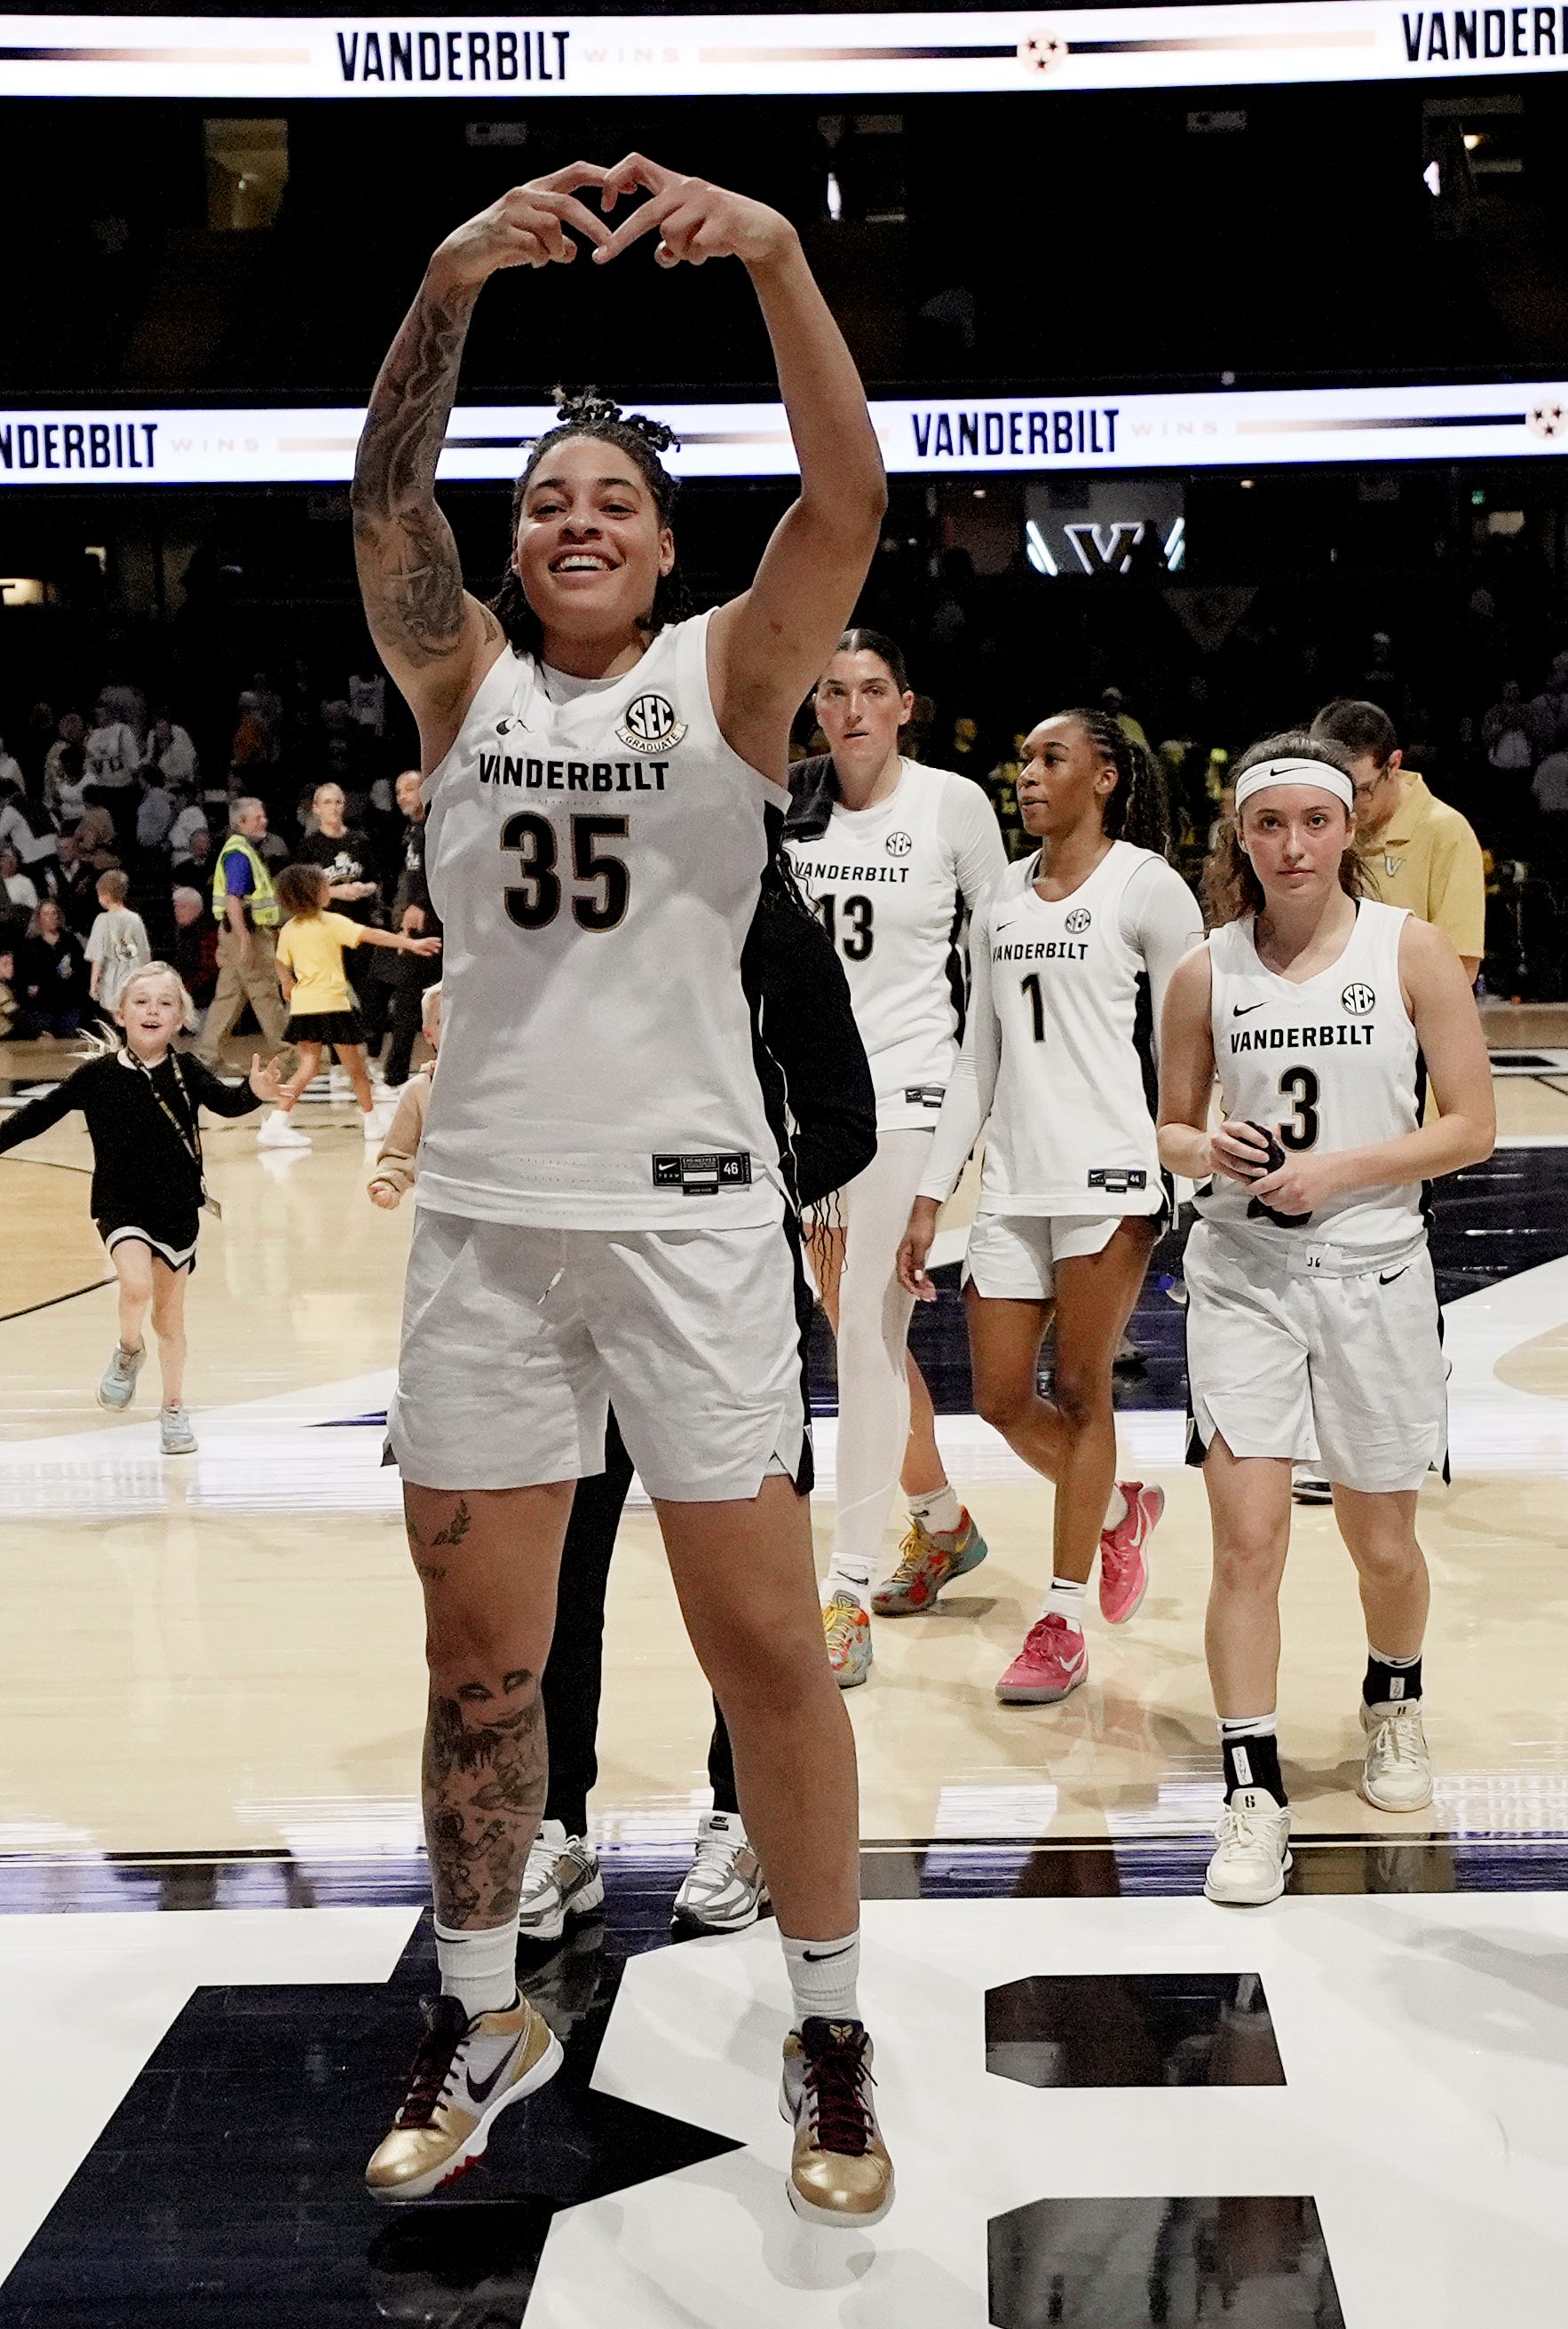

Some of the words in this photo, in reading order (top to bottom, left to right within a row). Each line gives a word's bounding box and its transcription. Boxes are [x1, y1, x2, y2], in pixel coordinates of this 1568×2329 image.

[337, 31, 570, 82] VANDERBILT
[582, 47, 680, 63] WINS
[170, 439, 259, 453] WINS
[912, 408, 1120, 456] VANDERBILT
[1131, 421, 1219, 436] WINS
[628, 696, 673, 739] SEC
[625, 733, 681, 752] GRADUATE
[479, 753, 669, 792] VANDERBILT
[500, 811, 630, 934] 35
[796, 861, 909, 883] VANDERBILT
[815, 892, 875, 962] 13
[993, 942, 1089, 962] VANDERBILT
[1020, 971, 1046, 1042] 1
[1342, 984, 1375, 1015] SEC
[1231, 1025, 1374, 1054] VANDERBILT
[1278, 1065, 1320, 1153] 3
[724, 1162, 739, 1175] 46
